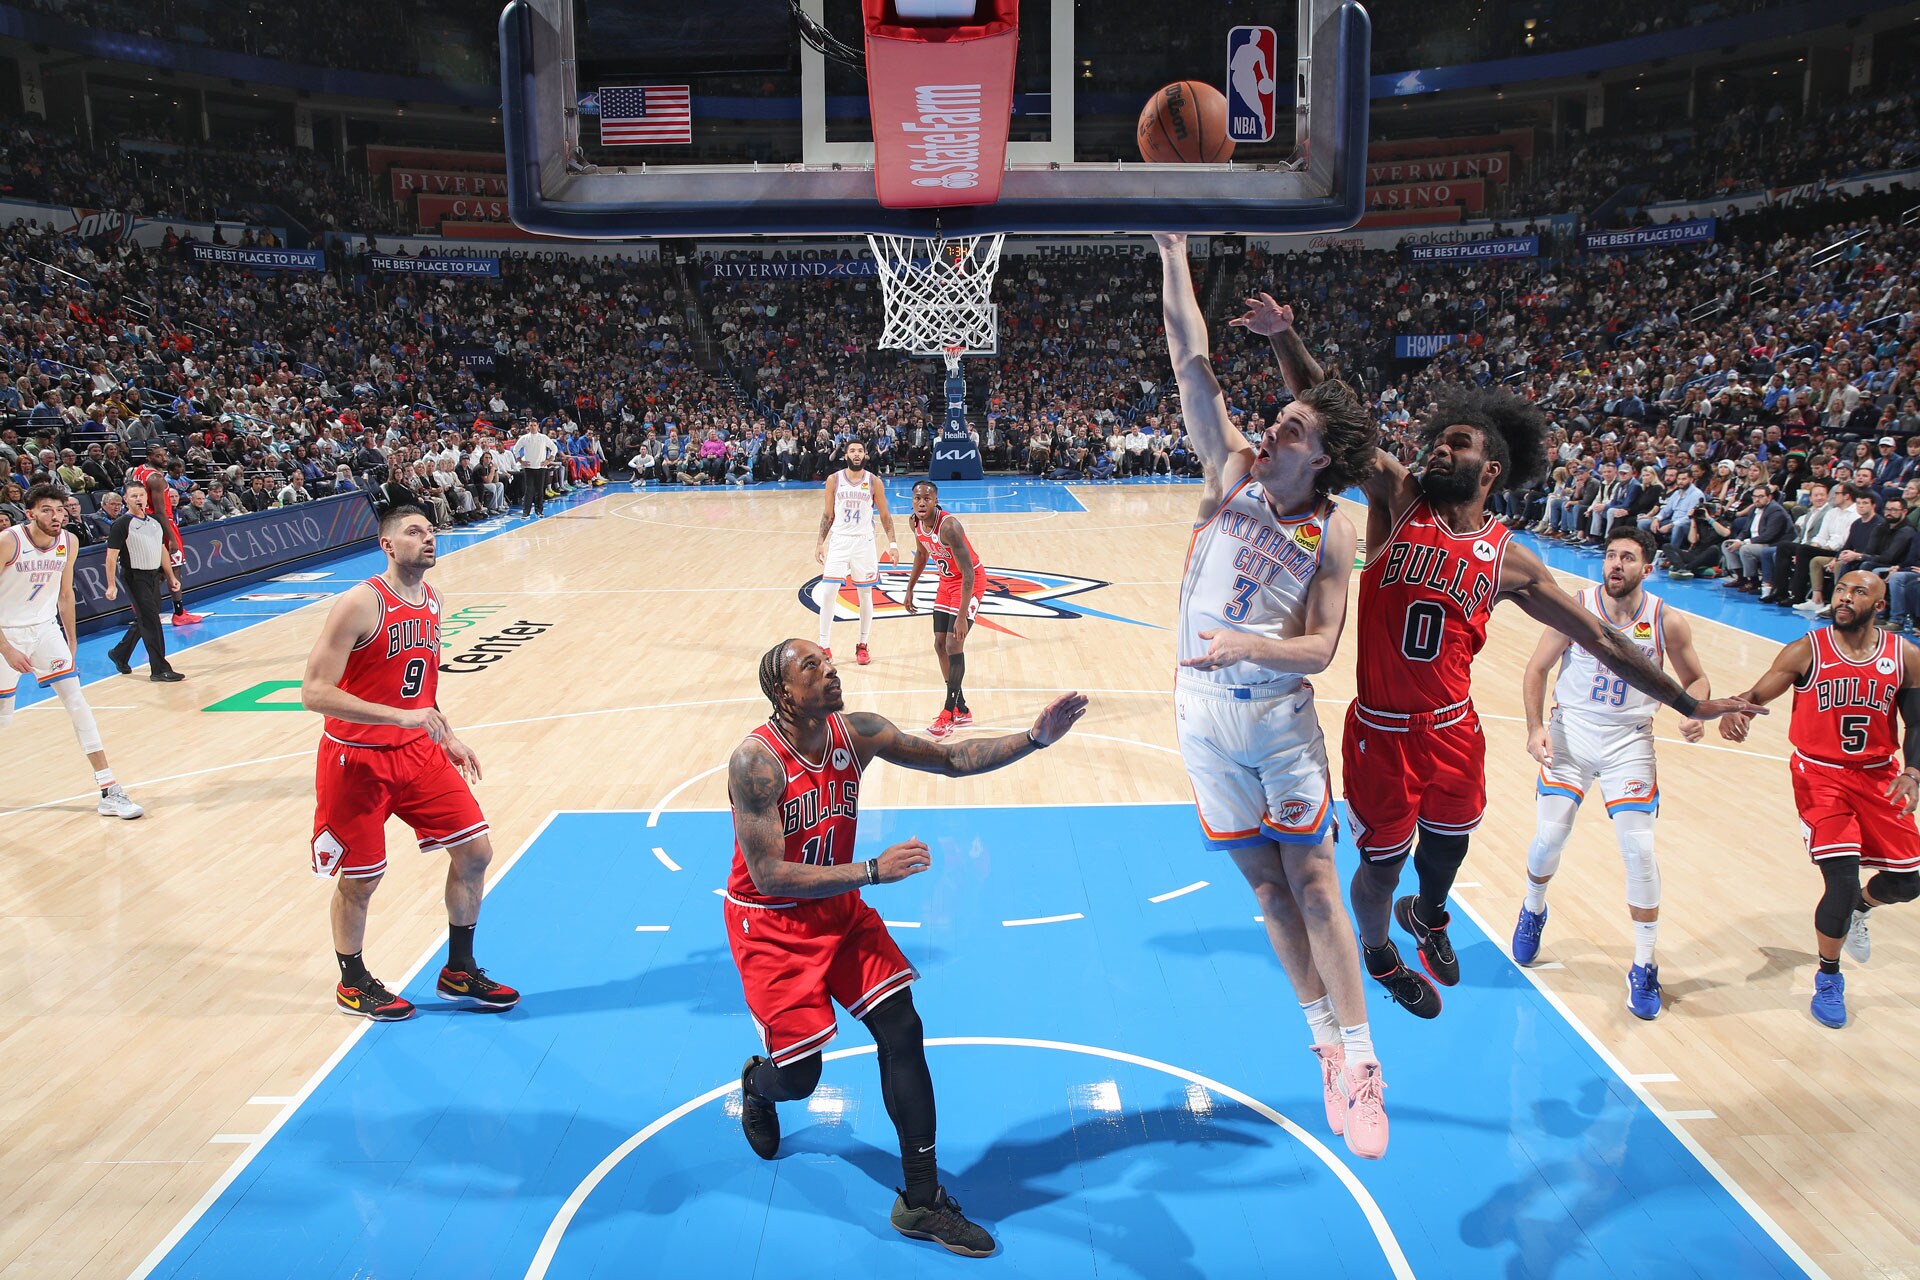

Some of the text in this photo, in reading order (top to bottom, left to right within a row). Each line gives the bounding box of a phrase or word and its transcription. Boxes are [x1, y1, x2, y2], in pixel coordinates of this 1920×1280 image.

[1165, 83, 1189, 141] Wilson
[1234, 116, 1256, 135] NBA
[1035, 244, 1145, 258] THUNDER
[1412, 242, 1532, 258] THE BEST PLACE TO PLAY
[1586, 225, 1708, 247] THE BEST PLACE TO PLAY
[193, 247, 316, 266] THE BEST PLACE TO PLAY
[372, 258, 491, 272] THE BEST PLACE TO PLAY
[713, 262, 827, 277] RIVERWIND
[944, 430, 967, 439] Health
[843, 508, 861, 524] 34
[225, 515, 322, 562] CASINO
[1220, 508, 1319, 584] OKLAHOMA
[1232, 545, 1285, 586] CITY
[1379, 541, 1492, 622] BULLS
[27, 584, 45, 602] 7
[1222, 574, 1262, 624] 3
[437, 620, 554, 674] center
[1401, 599, 1446, 662] 0
[400, 657, 426, 699] 9
[1590, 673, 1630, 708] 29
[1816, 677, 1897, 716] BULLS
[1840, 714, 1871, 755] 5
[783, 779, 858, 838] BULLS
[801, 825, 835, 867] 11
